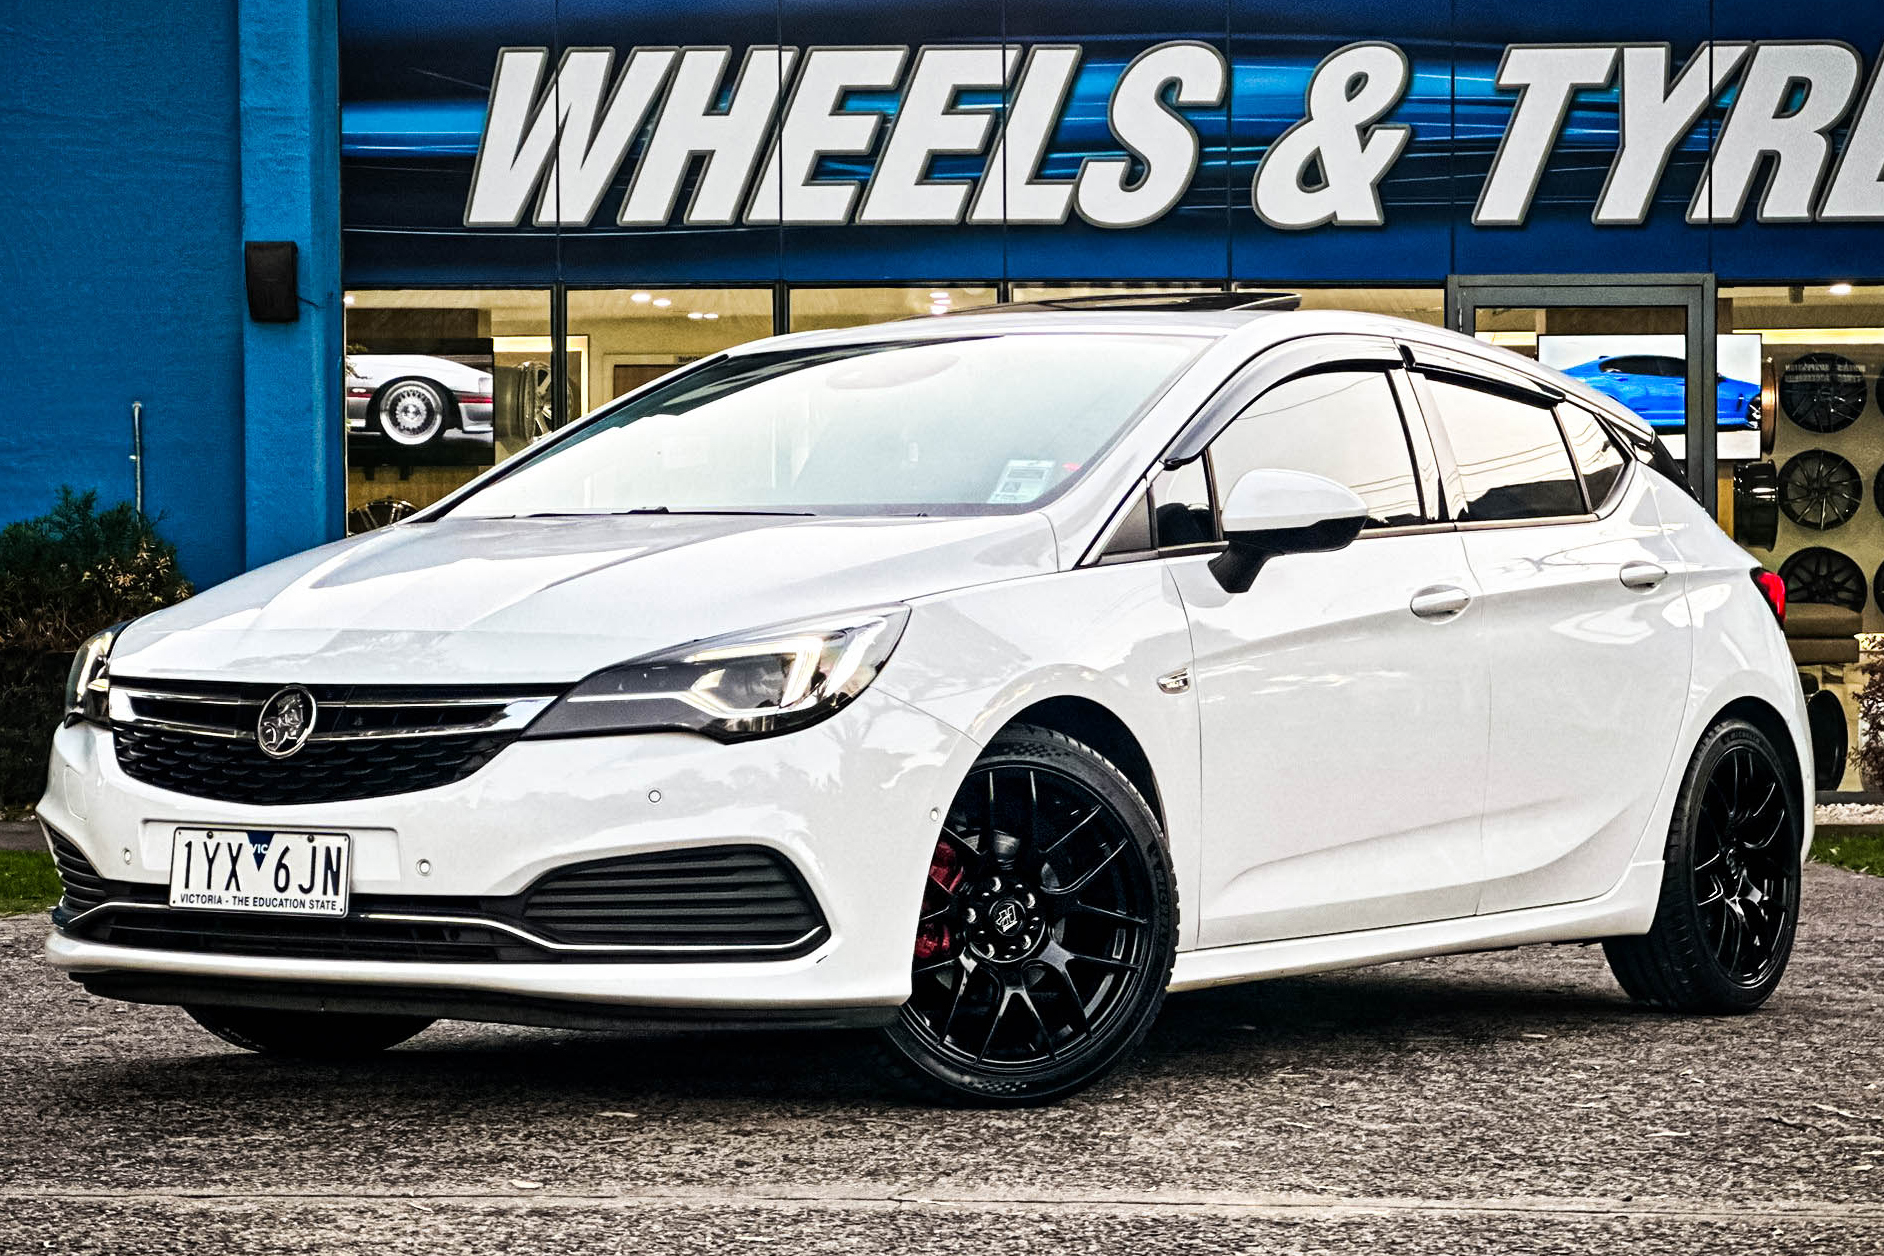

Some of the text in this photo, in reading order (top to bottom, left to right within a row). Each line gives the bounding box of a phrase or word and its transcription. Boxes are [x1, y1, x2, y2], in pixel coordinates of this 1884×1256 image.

[463, 39, 1228, 229] WHEELS
[1252, 41, 1412, 230] &
[252, 843, 269, 855] VIC
[184, 840, 342, 896] 1YX 6JN
[180, 893, 222, 905] VICTORIA
[232, 895, 250, 906] THE
[252, 896, 306, 909] EDUCATION
[308, 899, 337, 911] STATE
